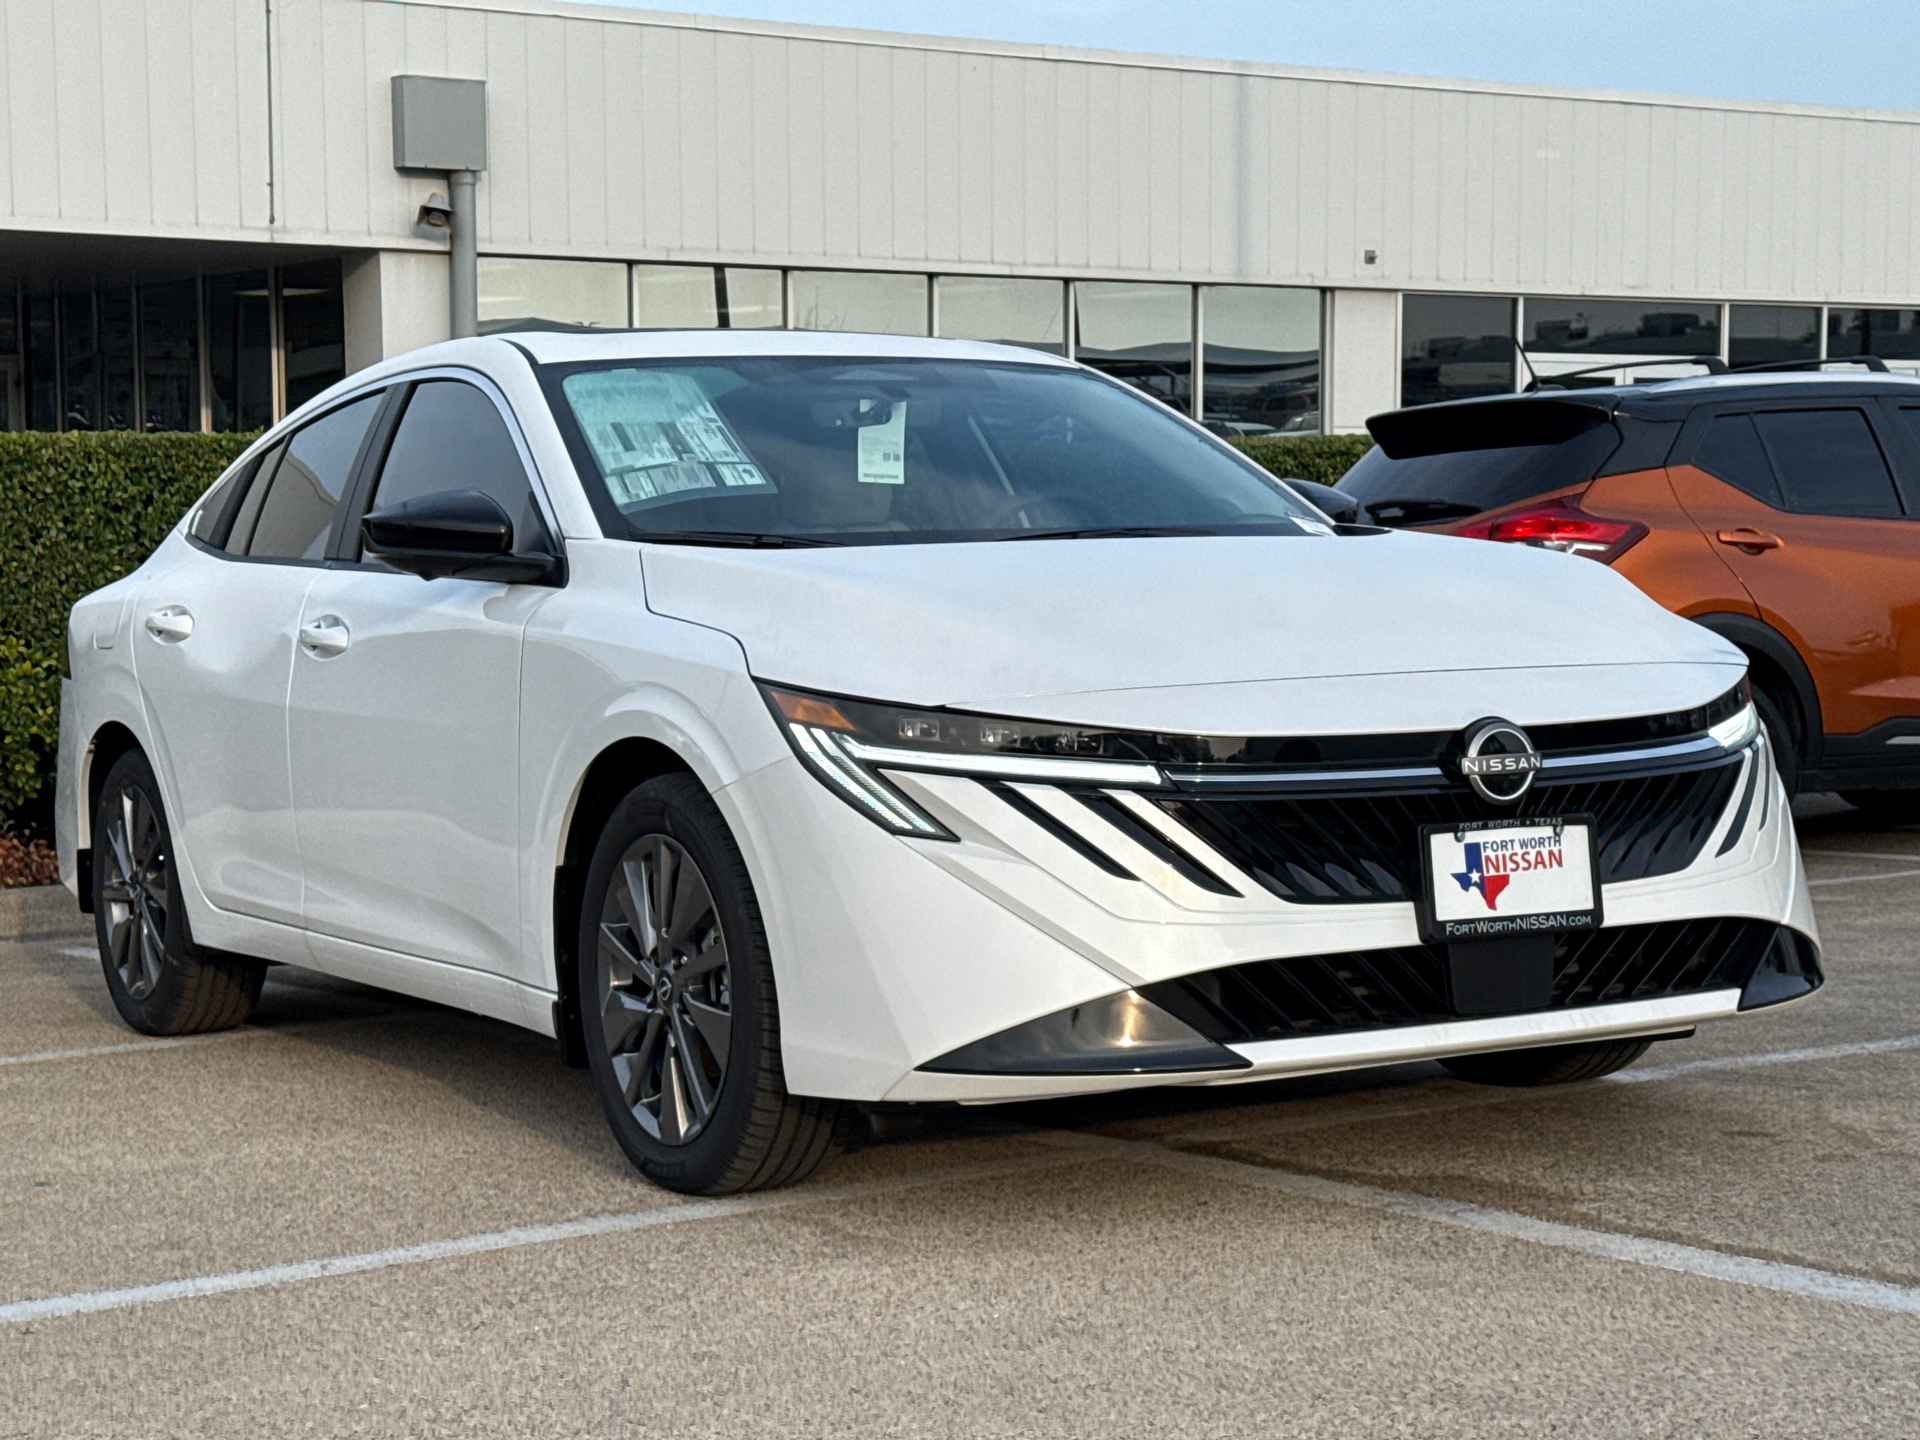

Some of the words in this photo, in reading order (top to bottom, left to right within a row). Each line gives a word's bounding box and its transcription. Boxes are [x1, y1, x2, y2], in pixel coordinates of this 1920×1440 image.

[1465, 757, 1541, 772] NISSAN
[1459, 821, 1483, 830] FORT
[1487, 819, 1521, 829] WORTH
[1535, 817, 1563, 826] TEXAS
[1483, 839, 1515, 853] FORT
[1518, 836, 1562, 850] WORTH
[1484, 849, 1563, 873] NISSAN
